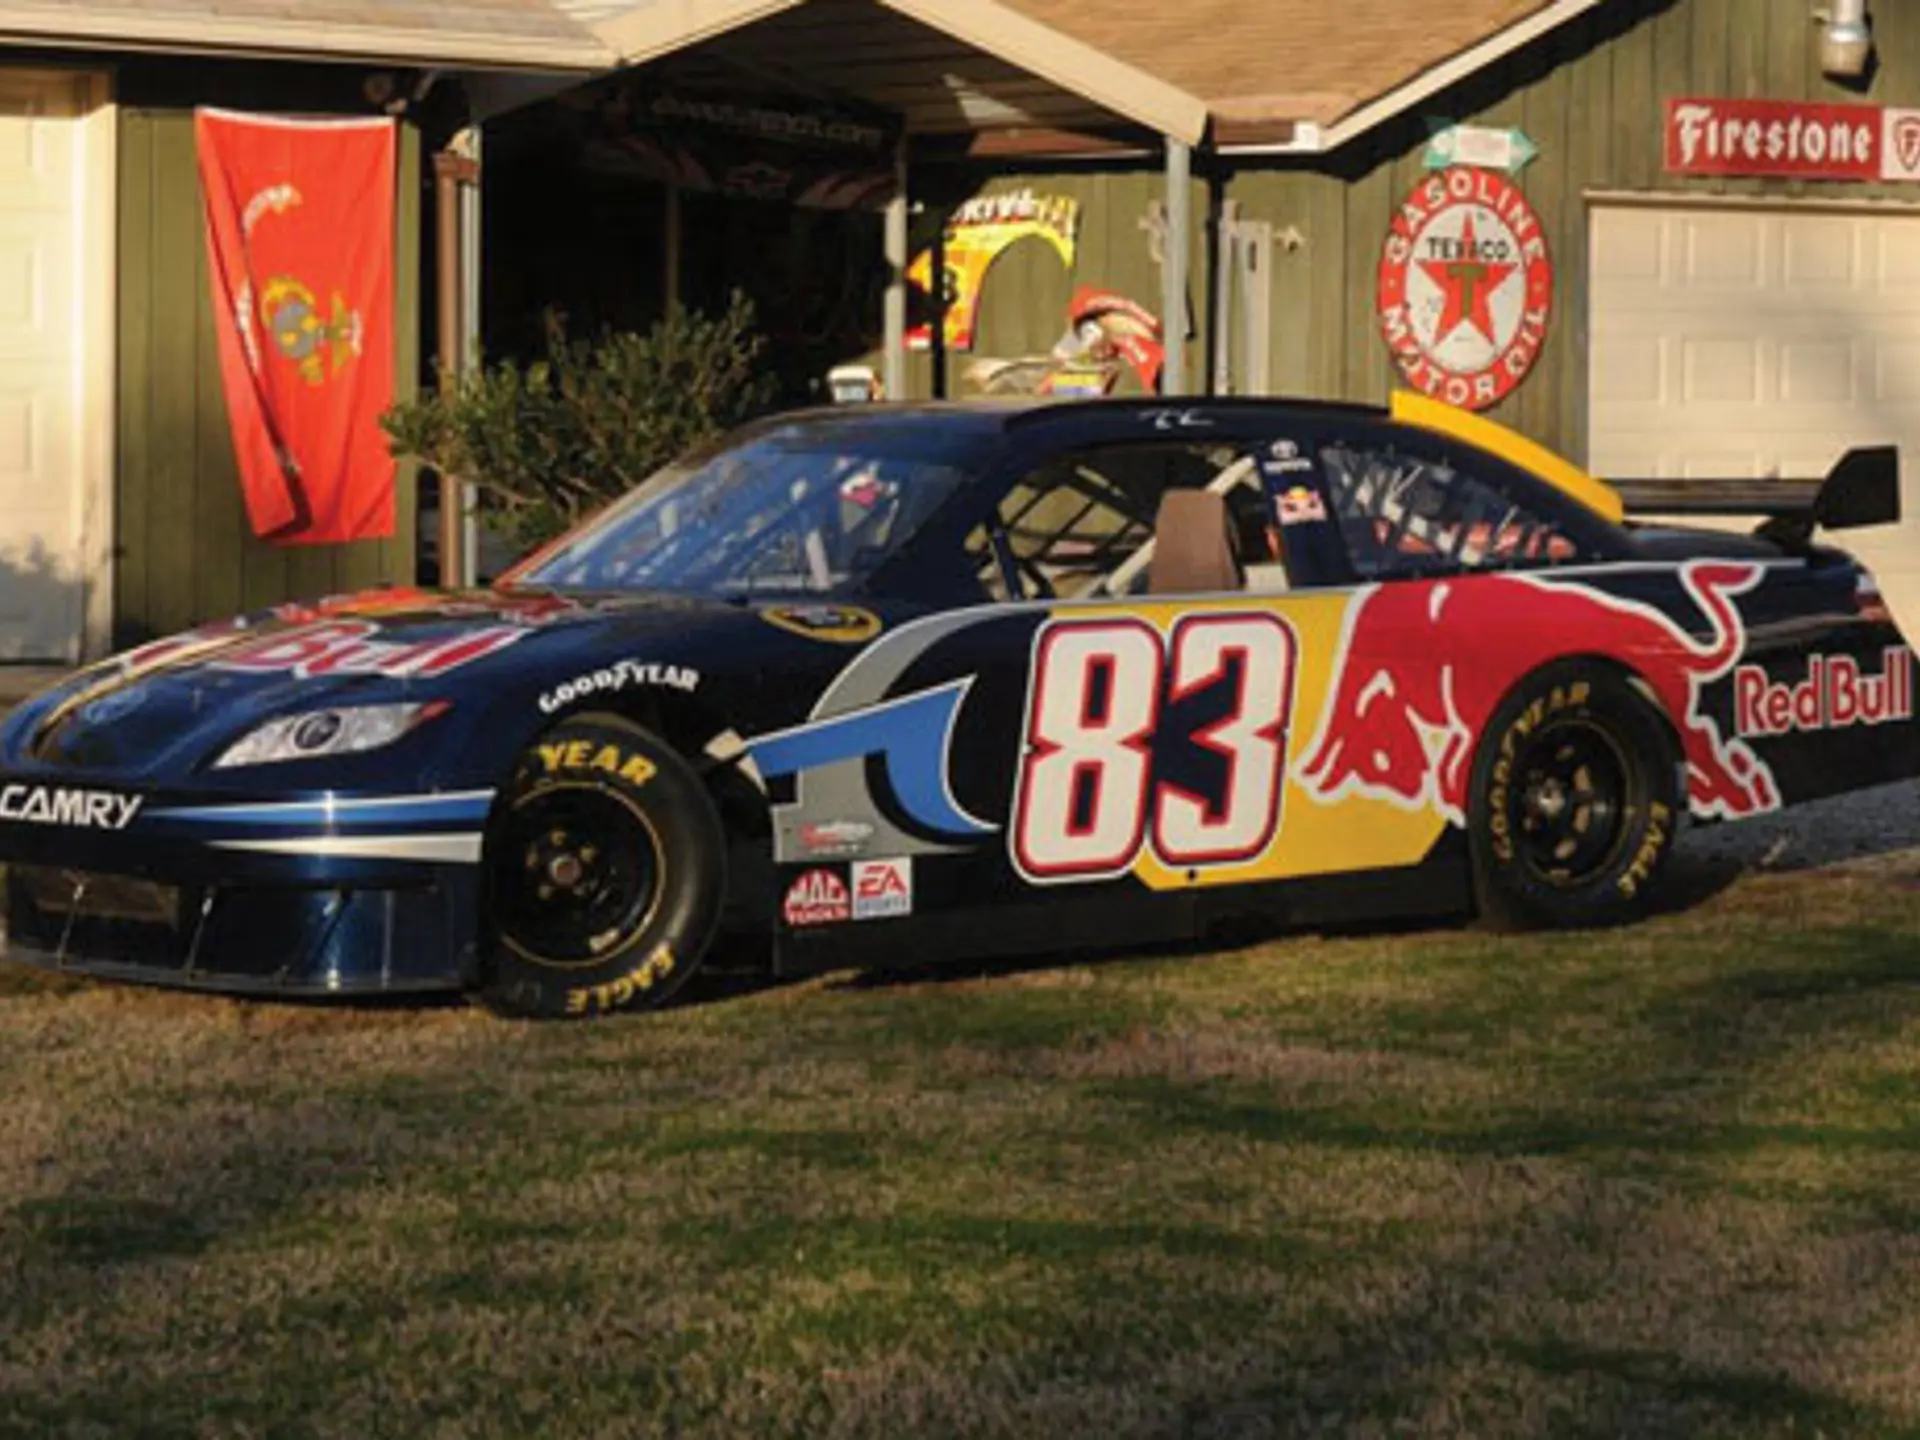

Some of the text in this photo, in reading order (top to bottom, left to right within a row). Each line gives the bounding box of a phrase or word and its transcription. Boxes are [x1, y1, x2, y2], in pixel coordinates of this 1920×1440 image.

[1674, 103, 1873, 167] Firestone
[1385, 168, 1547, 265] GASOLINE
[1426, 237, 1510, 258] TEXACO
[1382, 304, 1547, 403] MOTOR OIL
[538, 656, 700, 714] GOODYEAR
[1735, 645, 1912, 738] Red Bull
[1008, 611, 1298, 884] 83
[0, 783, 144, 830] CAMRY
[564, 941, 676, 1014] EAGLE
